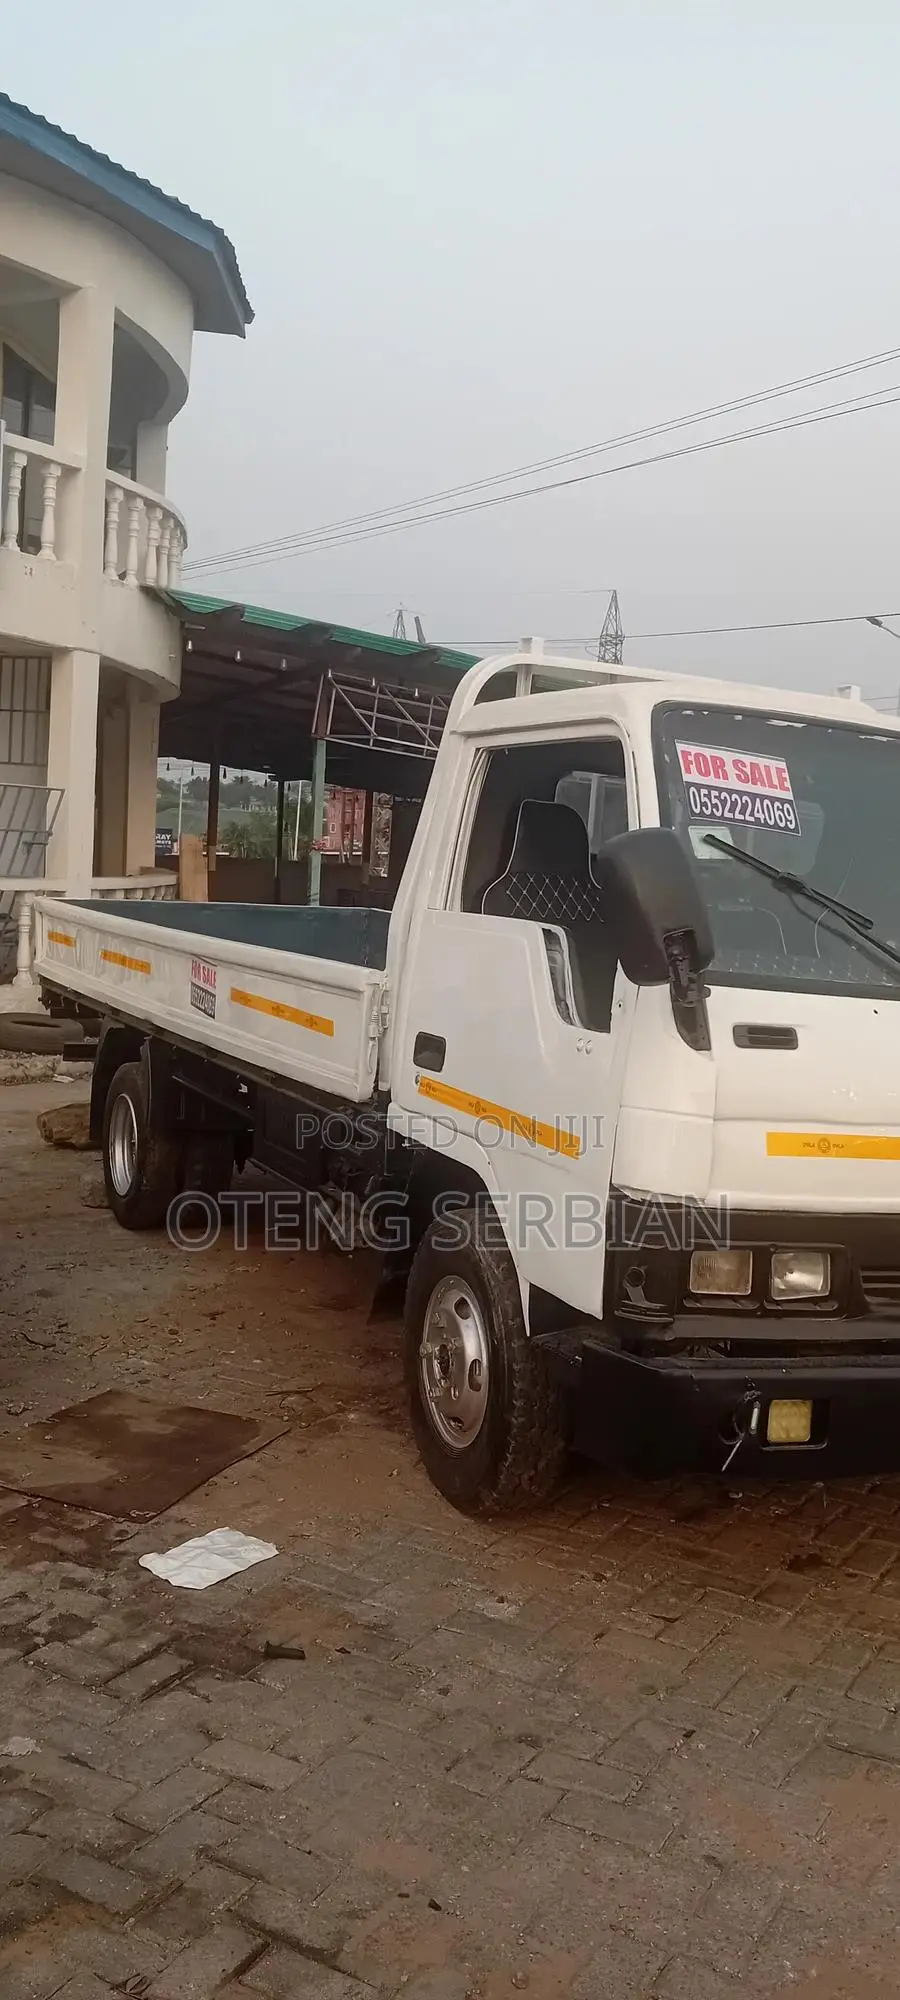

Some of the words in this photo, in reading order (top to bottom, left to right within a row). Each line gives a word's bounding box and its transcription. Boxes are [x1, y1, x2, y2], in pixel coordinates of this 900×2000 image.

[680, 750, 729, 781] FOR
[732, 758, 790, 792] SALE
[689, 786, 796, 829] 0552224069
[202, 965, 217, 989] SALE
